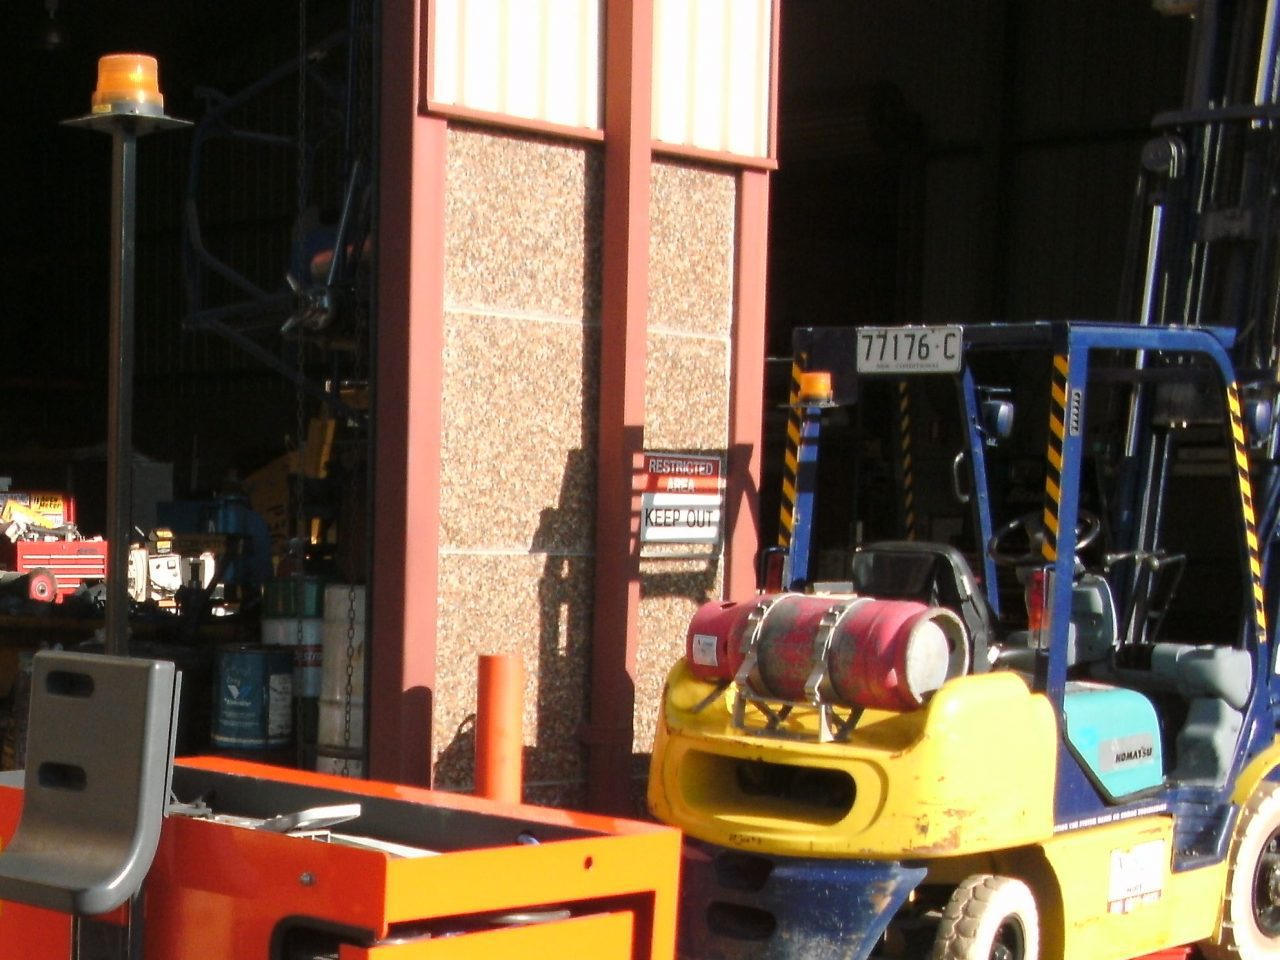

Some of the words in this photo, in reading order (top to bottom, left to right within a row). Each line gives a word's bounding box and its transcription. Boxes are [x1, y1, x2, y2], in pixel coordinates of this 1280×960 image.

[648, 458, 714, 476] RESTRICTED
[667, 477, 696, 493] AREA
[645, 508, 681, 528] KEEP
[686, 508, 714, 528] OUT
[1115, 747, 1153, 764] KOMATSU
